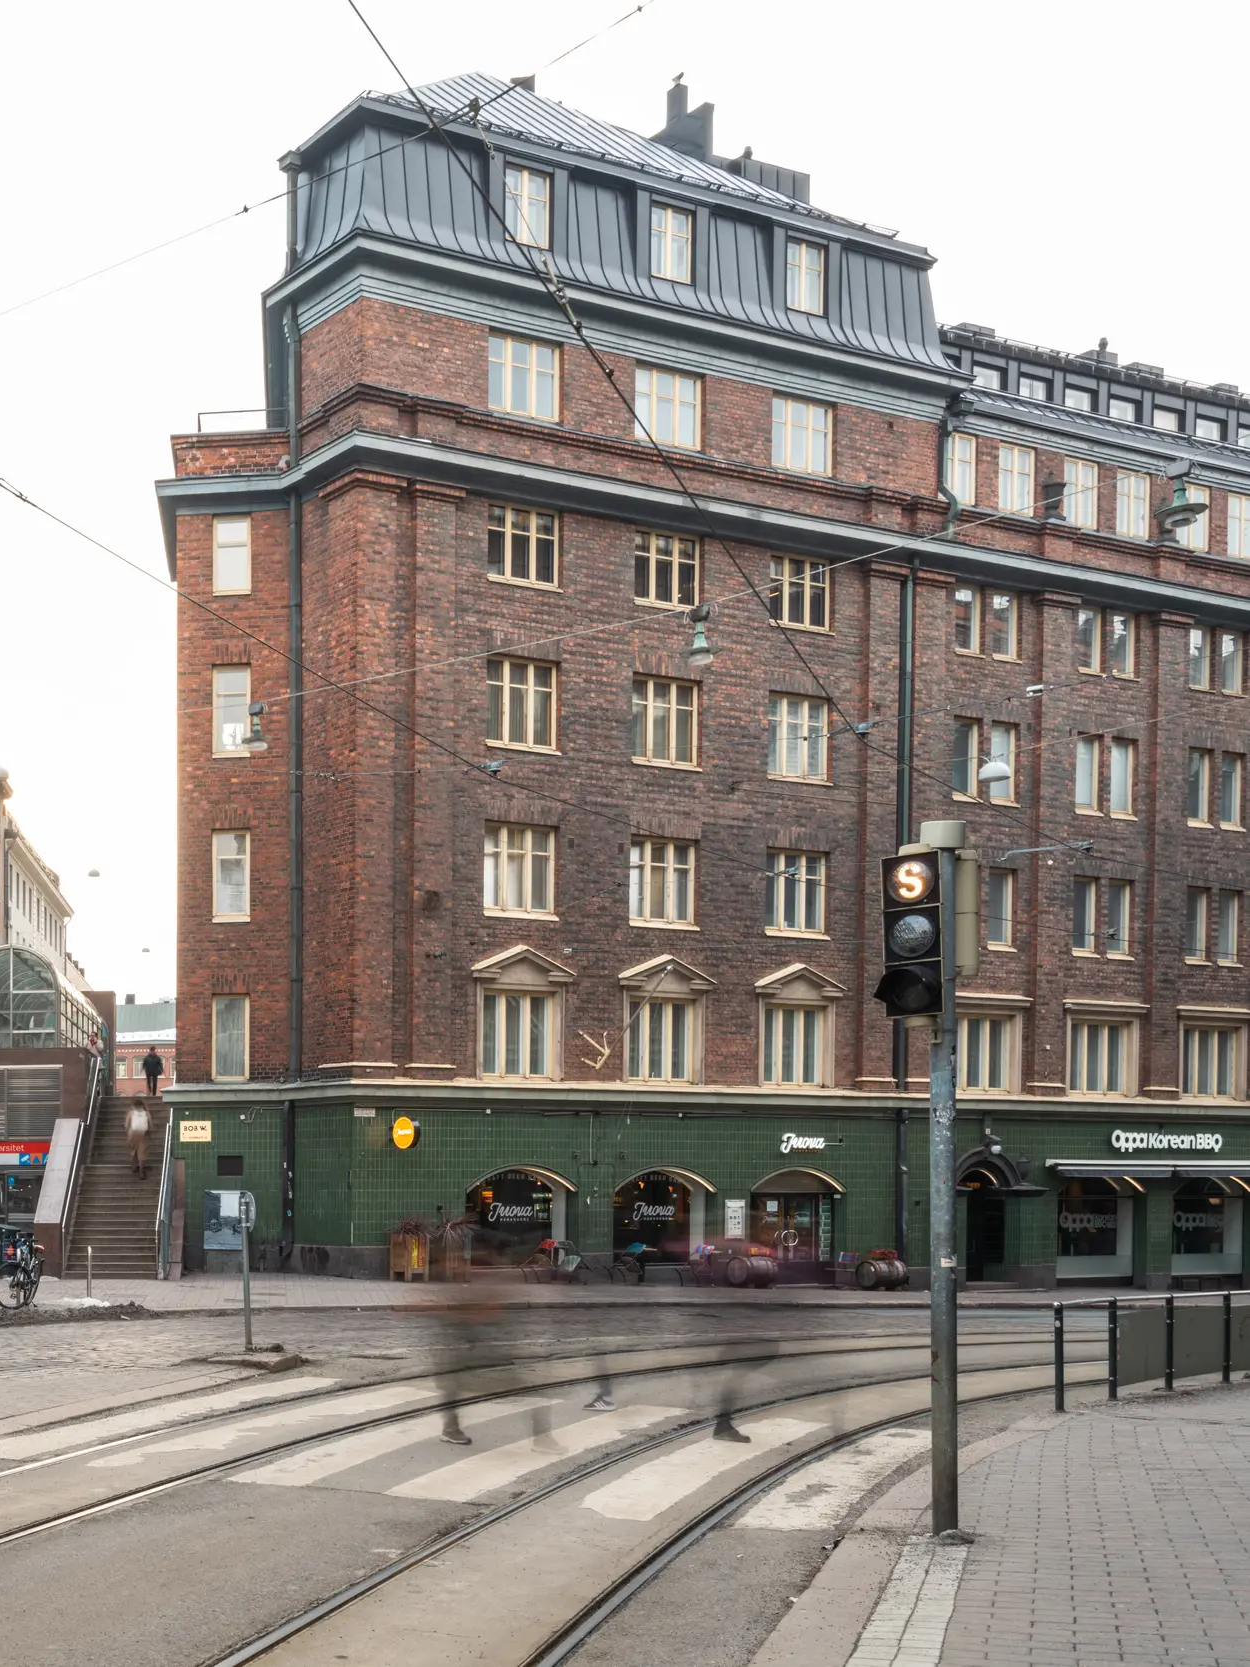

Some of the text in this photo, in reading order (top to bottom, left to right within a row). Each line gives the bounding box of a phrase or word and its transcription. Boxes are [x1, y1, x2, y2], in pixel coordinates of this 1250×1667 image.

[898, 863, 922, 899] S
[780, 1132, 826, 1153] Juova
[1111, 1129, 1223, 1153] Oppa Korean BBQ
[488, 1202, 534, 1222] Juova
[632, 1202, 675, 1221] Juova
[1059, 1211, 1094, 1233] Oppa
[1173, 1211, 1207, 1231] Oppa
